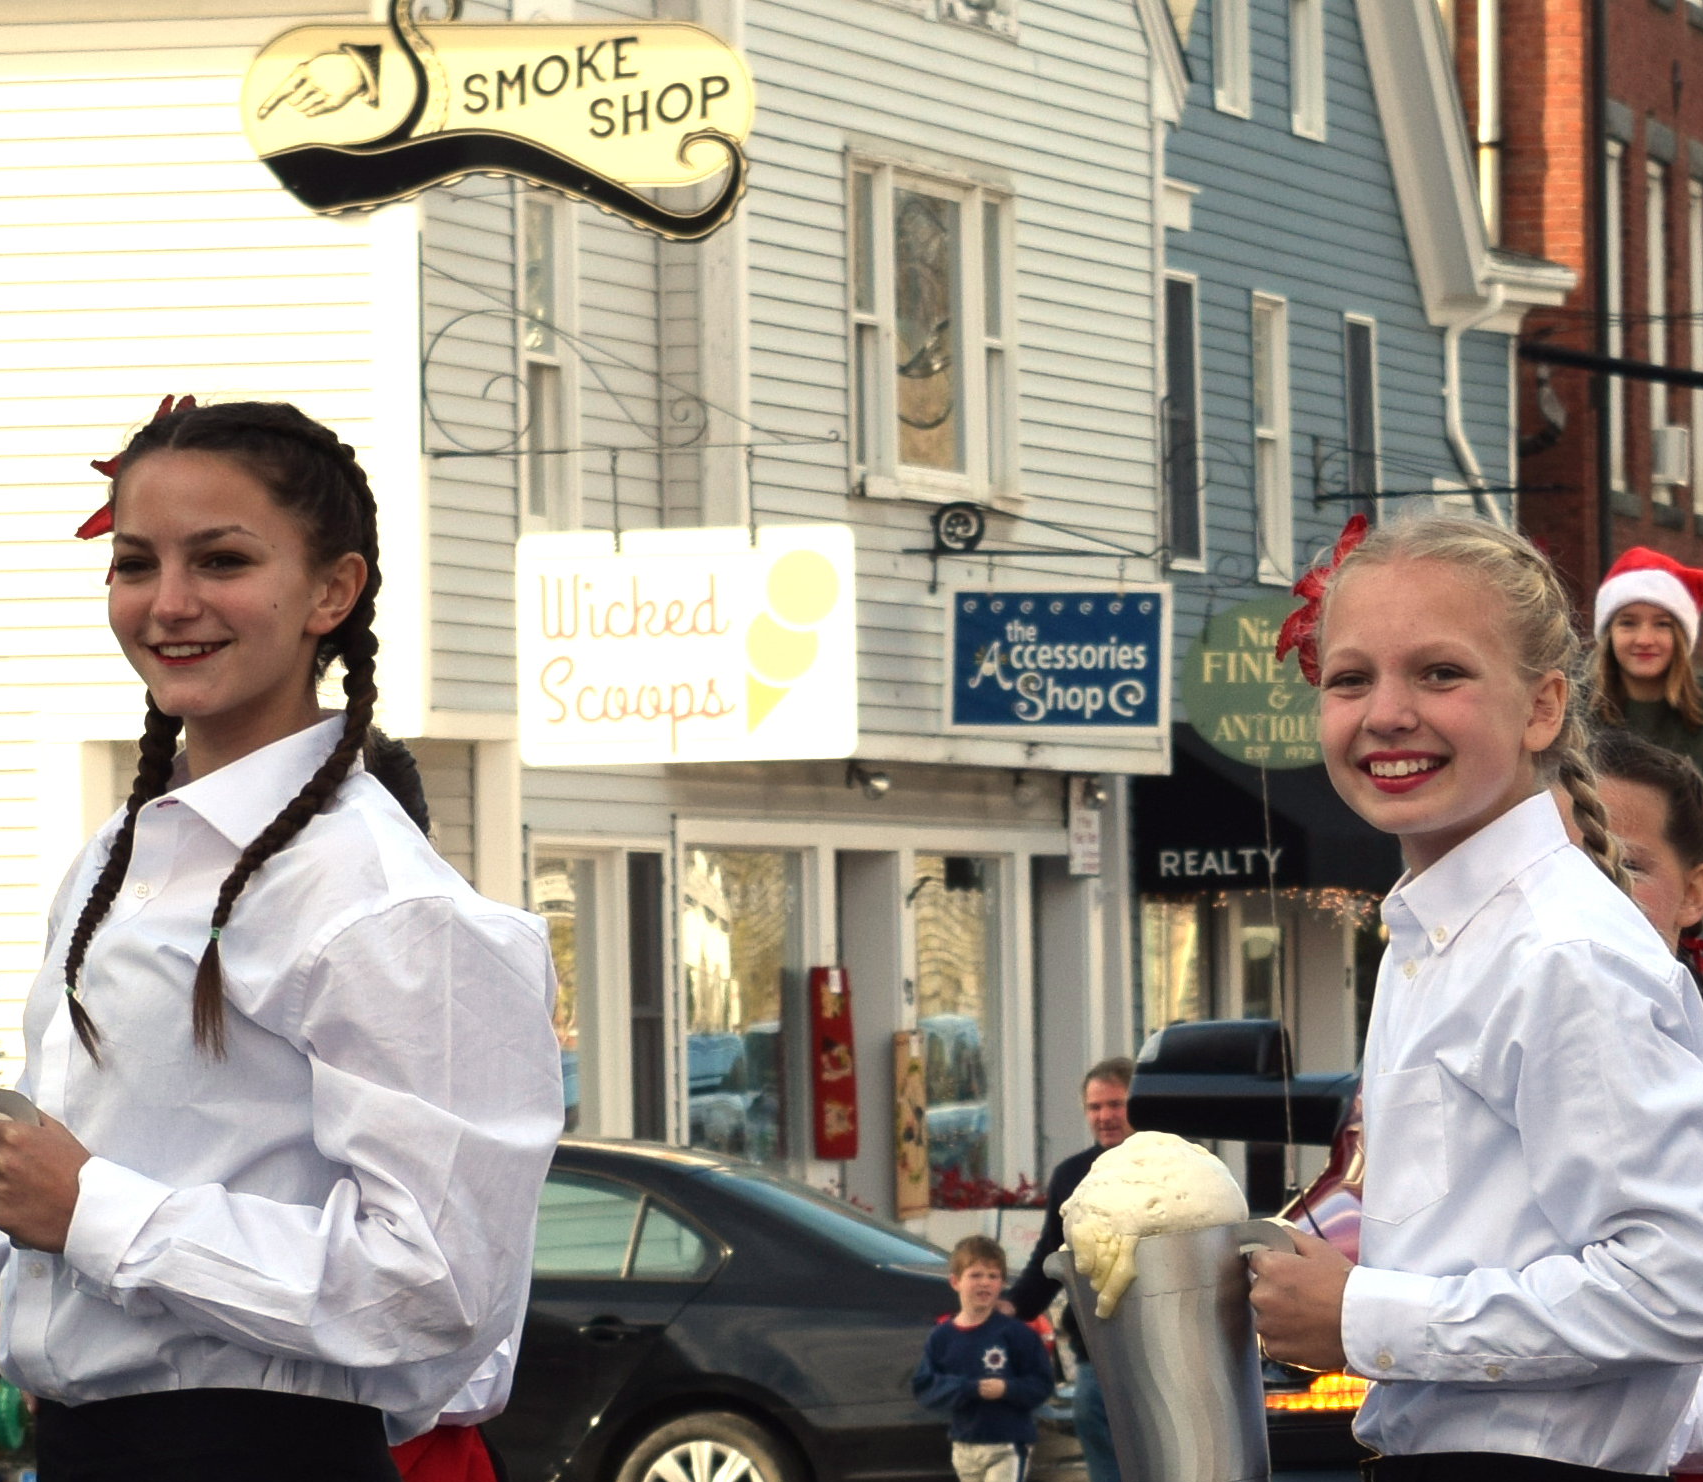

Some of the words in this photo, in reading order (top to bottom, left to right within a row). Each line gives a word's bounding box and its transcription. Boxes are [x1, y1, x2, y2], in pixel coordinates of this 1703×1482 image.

[463, 36, 640, 115] SMOKE
[589, 76, 731, 138] SHOP
[539, 573, 730, 640] Wicked
[1005, 618, 1037, 642] the
[968, 635, 1146, 690] Accessories
[1202, 652, 1285, 683] FINE
[538, 655, 736, 756] Scoops
[1015, 672, 1104, 721] Shop
[1268, 684, 1293, 709] &
[1159, 849, 1282, 877] REALTY
